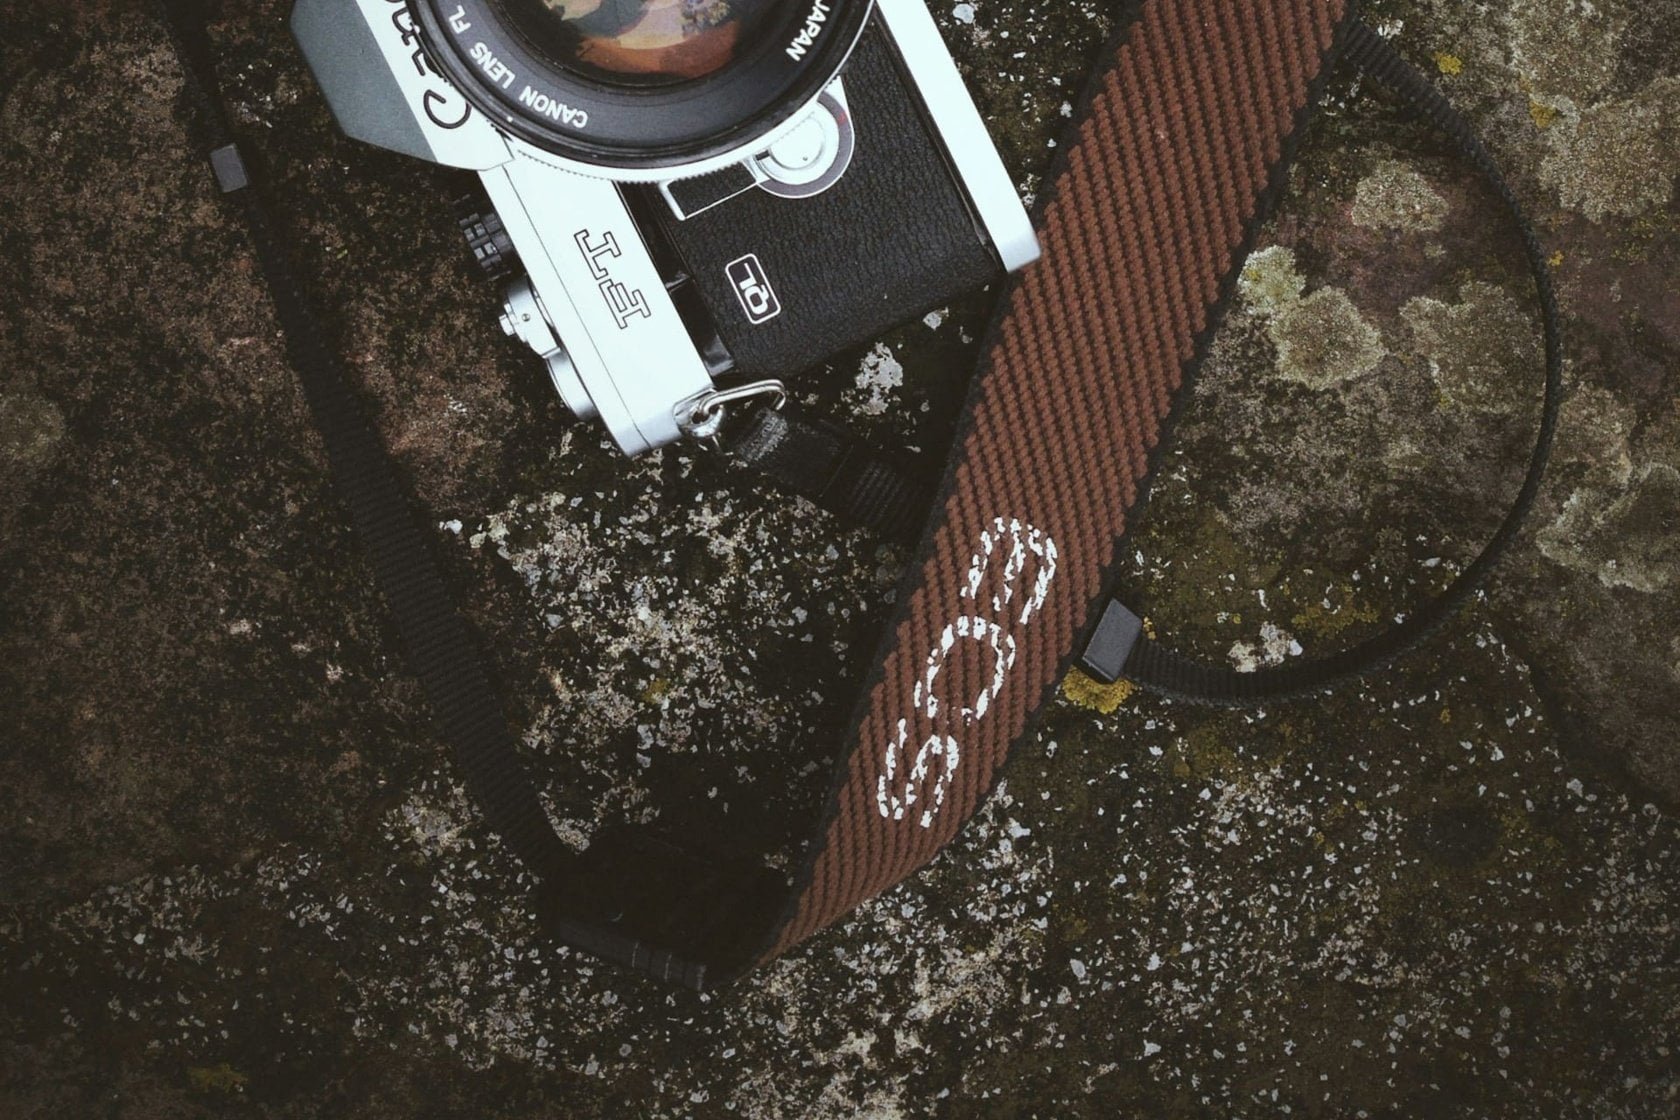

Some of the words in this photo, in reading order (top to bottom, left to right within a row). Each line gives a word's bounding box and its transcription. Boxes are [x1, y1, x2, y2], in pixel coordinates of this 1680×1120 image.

[449, 4, 472, 34] FL
[469, 41, 516, 89] LENS
[519, 84, 588, 129] CANON
[573, 228, 651, 330] FT
